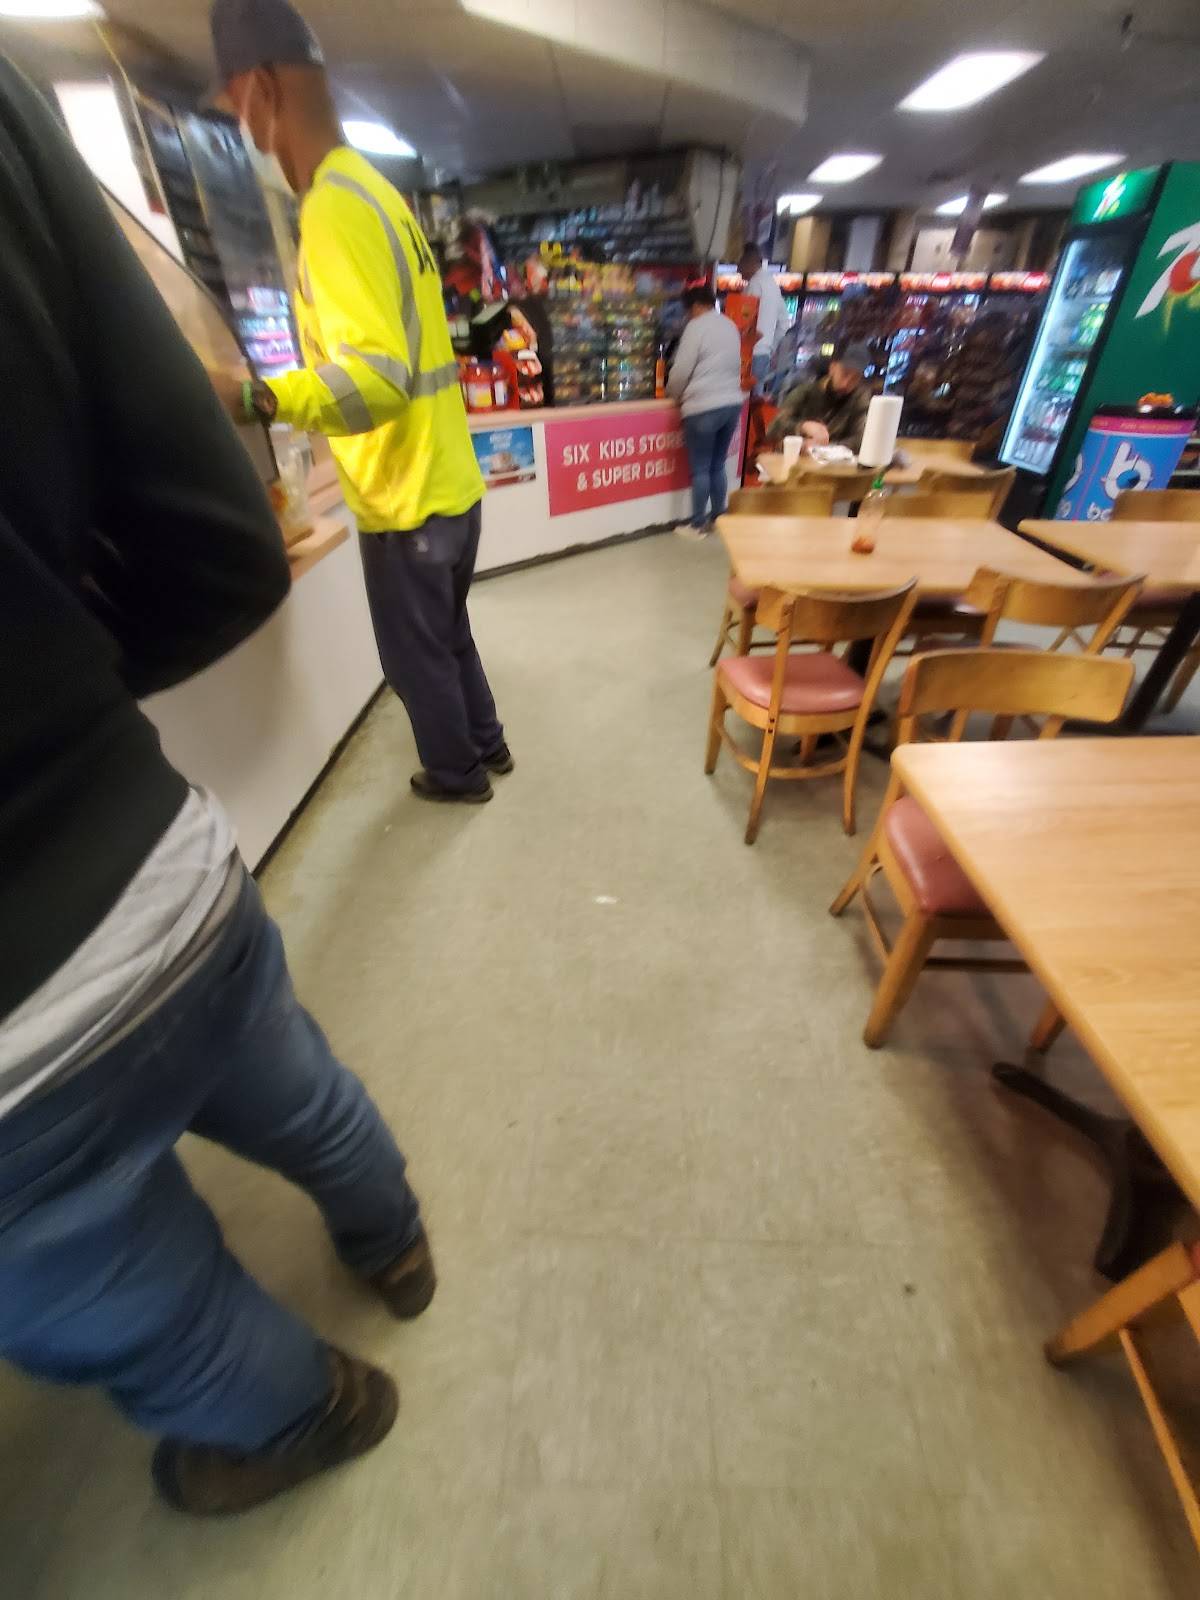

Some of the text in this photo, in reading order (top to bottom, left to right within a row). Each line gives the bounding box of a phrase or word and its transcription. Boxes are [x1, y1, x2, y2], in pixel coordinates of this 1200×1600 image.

[562, 443, 591, 467] SIX
[599, 435, 635, 460] KIDS
[576, 457, 677, 492] & SUPER DELI
